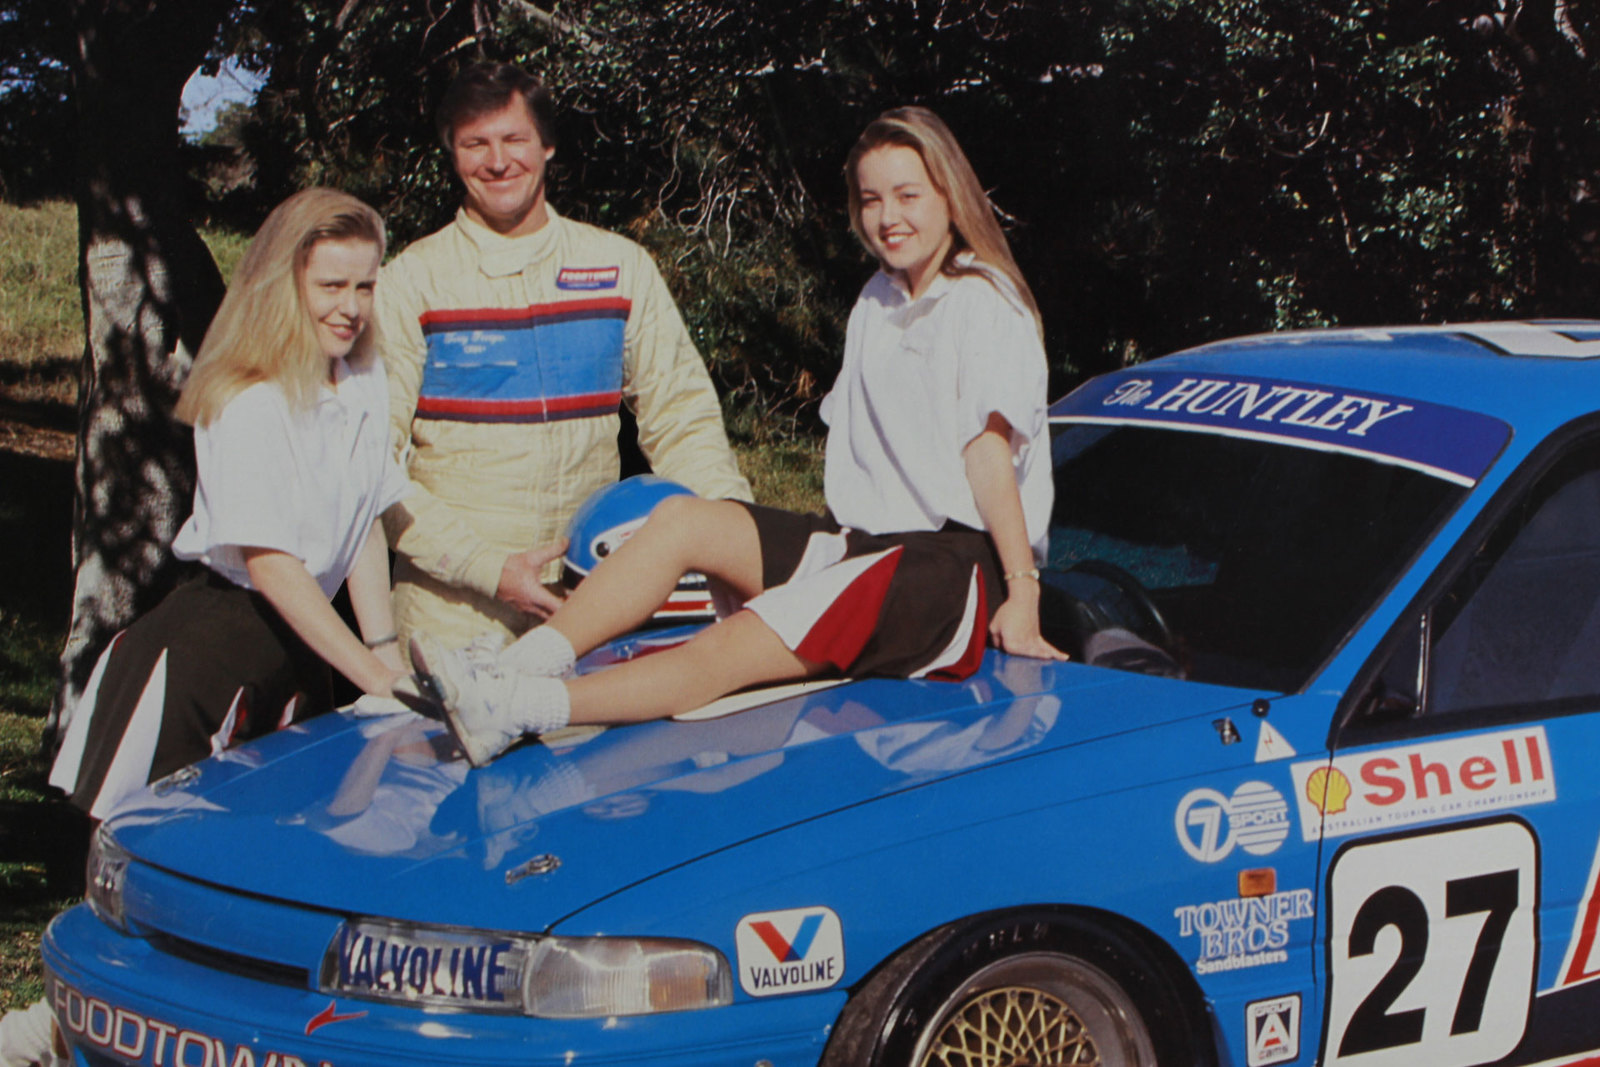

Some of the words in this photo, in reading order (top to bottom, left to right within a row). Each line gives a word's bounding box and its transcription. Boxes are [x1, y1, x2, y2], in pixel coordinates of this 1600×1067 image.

[1103, 379, 1153, 407] The
[1144, 378, 1414, 437] HUNTLEY
[1360, 736, 1544, 806] Shell
[1228, 808, 1288, 828] SPORT
[1312, 816, 1382, 833] ASTRALIAN
[1388, 807, 1436, 821] TOURING
[1441, 802, 1462, 813] CAR
[1467, 788, 1548, 808] CHAMPIONSHIP
[1174, 888, 1314, 937] TOWNER
[338, 924, 512, 1000] VALVOLINE
[1196, 950, 1288, 975] Sandblasters
[1199, 920, 1289, 960] BROS
[1337, 868, 1519, 1059] 27
[750, 957, 835, 990] VALVOLINE
[54, 979, 333, 1067] FOODTOW
